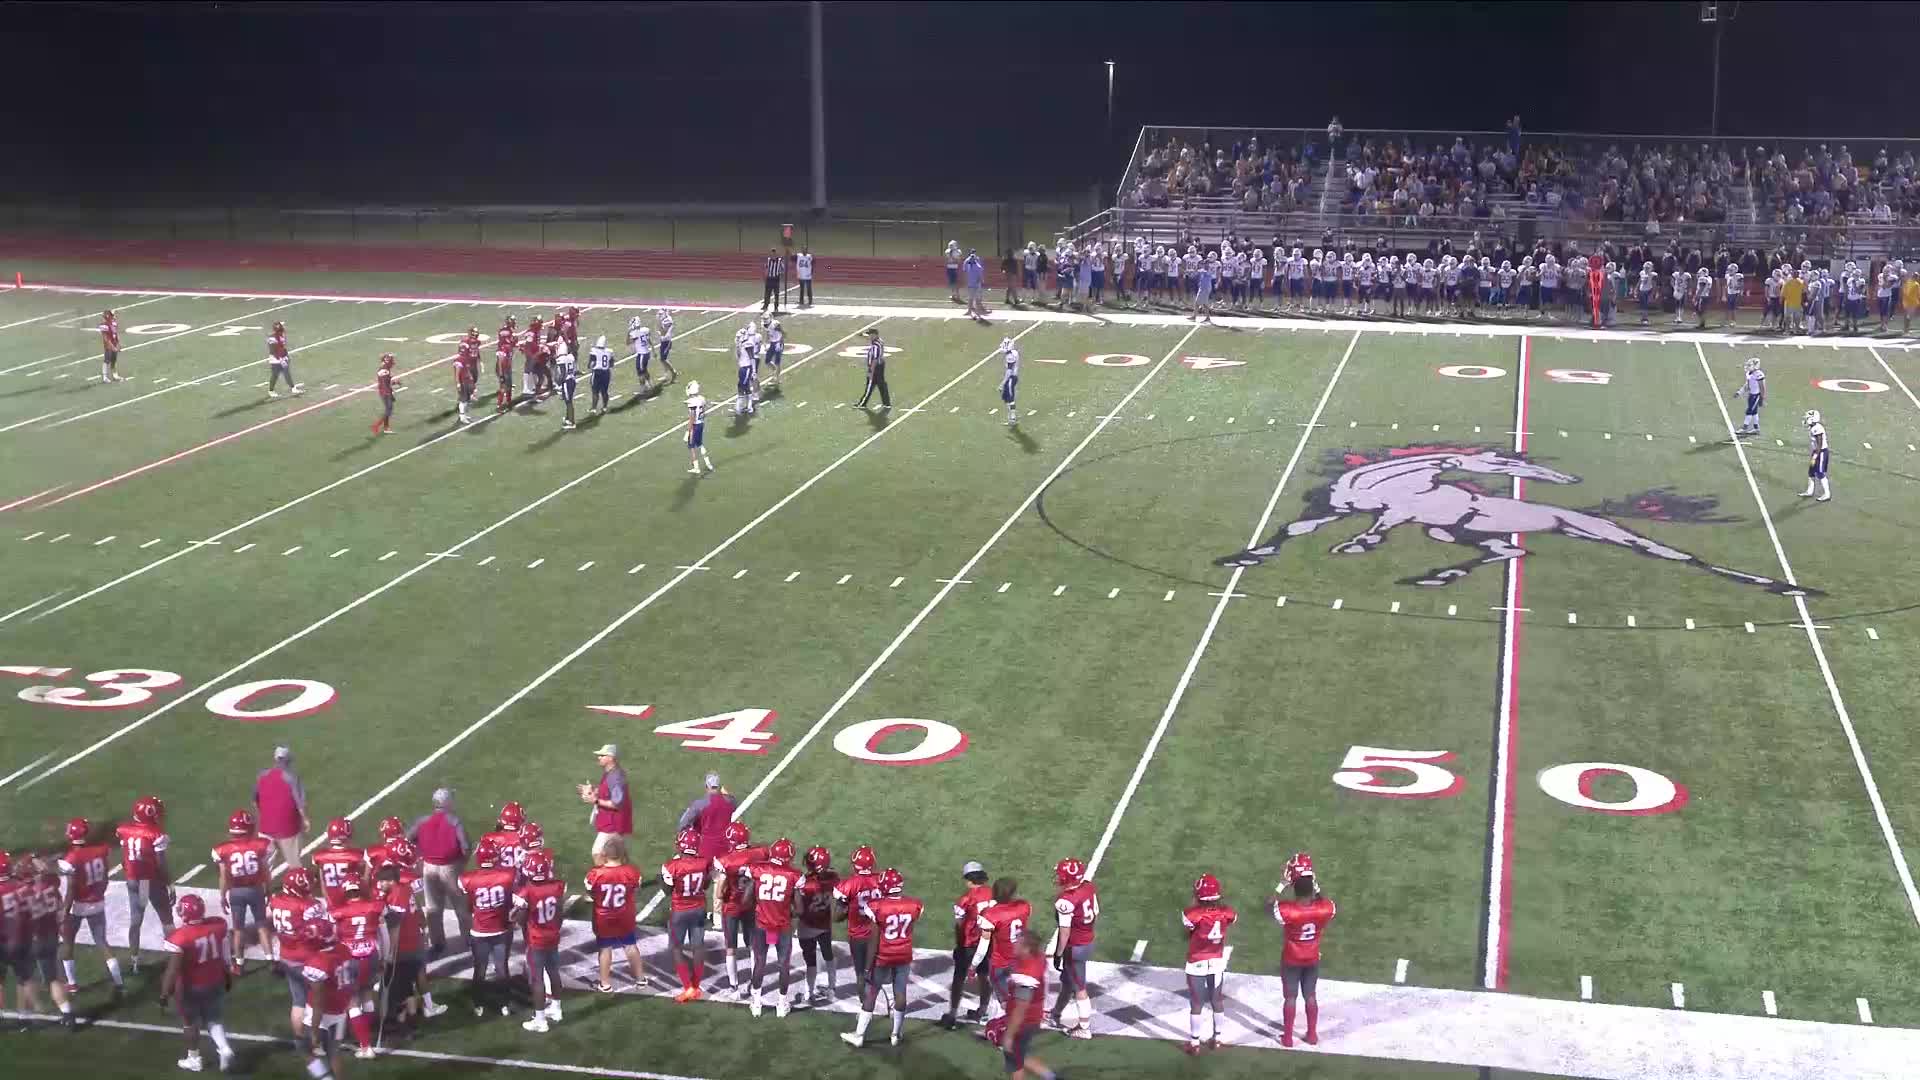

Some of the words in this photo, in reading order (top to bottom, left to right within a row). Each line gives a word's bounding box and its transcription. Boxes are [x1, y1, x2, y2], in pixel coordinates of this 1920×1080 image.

[127, 836, 142, 861] 11
[229, 850, 259, 877] 26
[323, 862, 349, 888] 25
[475, 884, 505, 910] 20
[600, 883, 626, 908] 72
[682, 871, 704, 897] 17
[758, 873, 788, 902] 22
[272, 907, 297, 935] 65
[351, 916, 367, 940] 7
[884, 913, 912, 940] 27
[1207, 920, 1223, 944] 4
[1299, 922, 1317, 942] 2
[194, 932, 219, 964] 71
